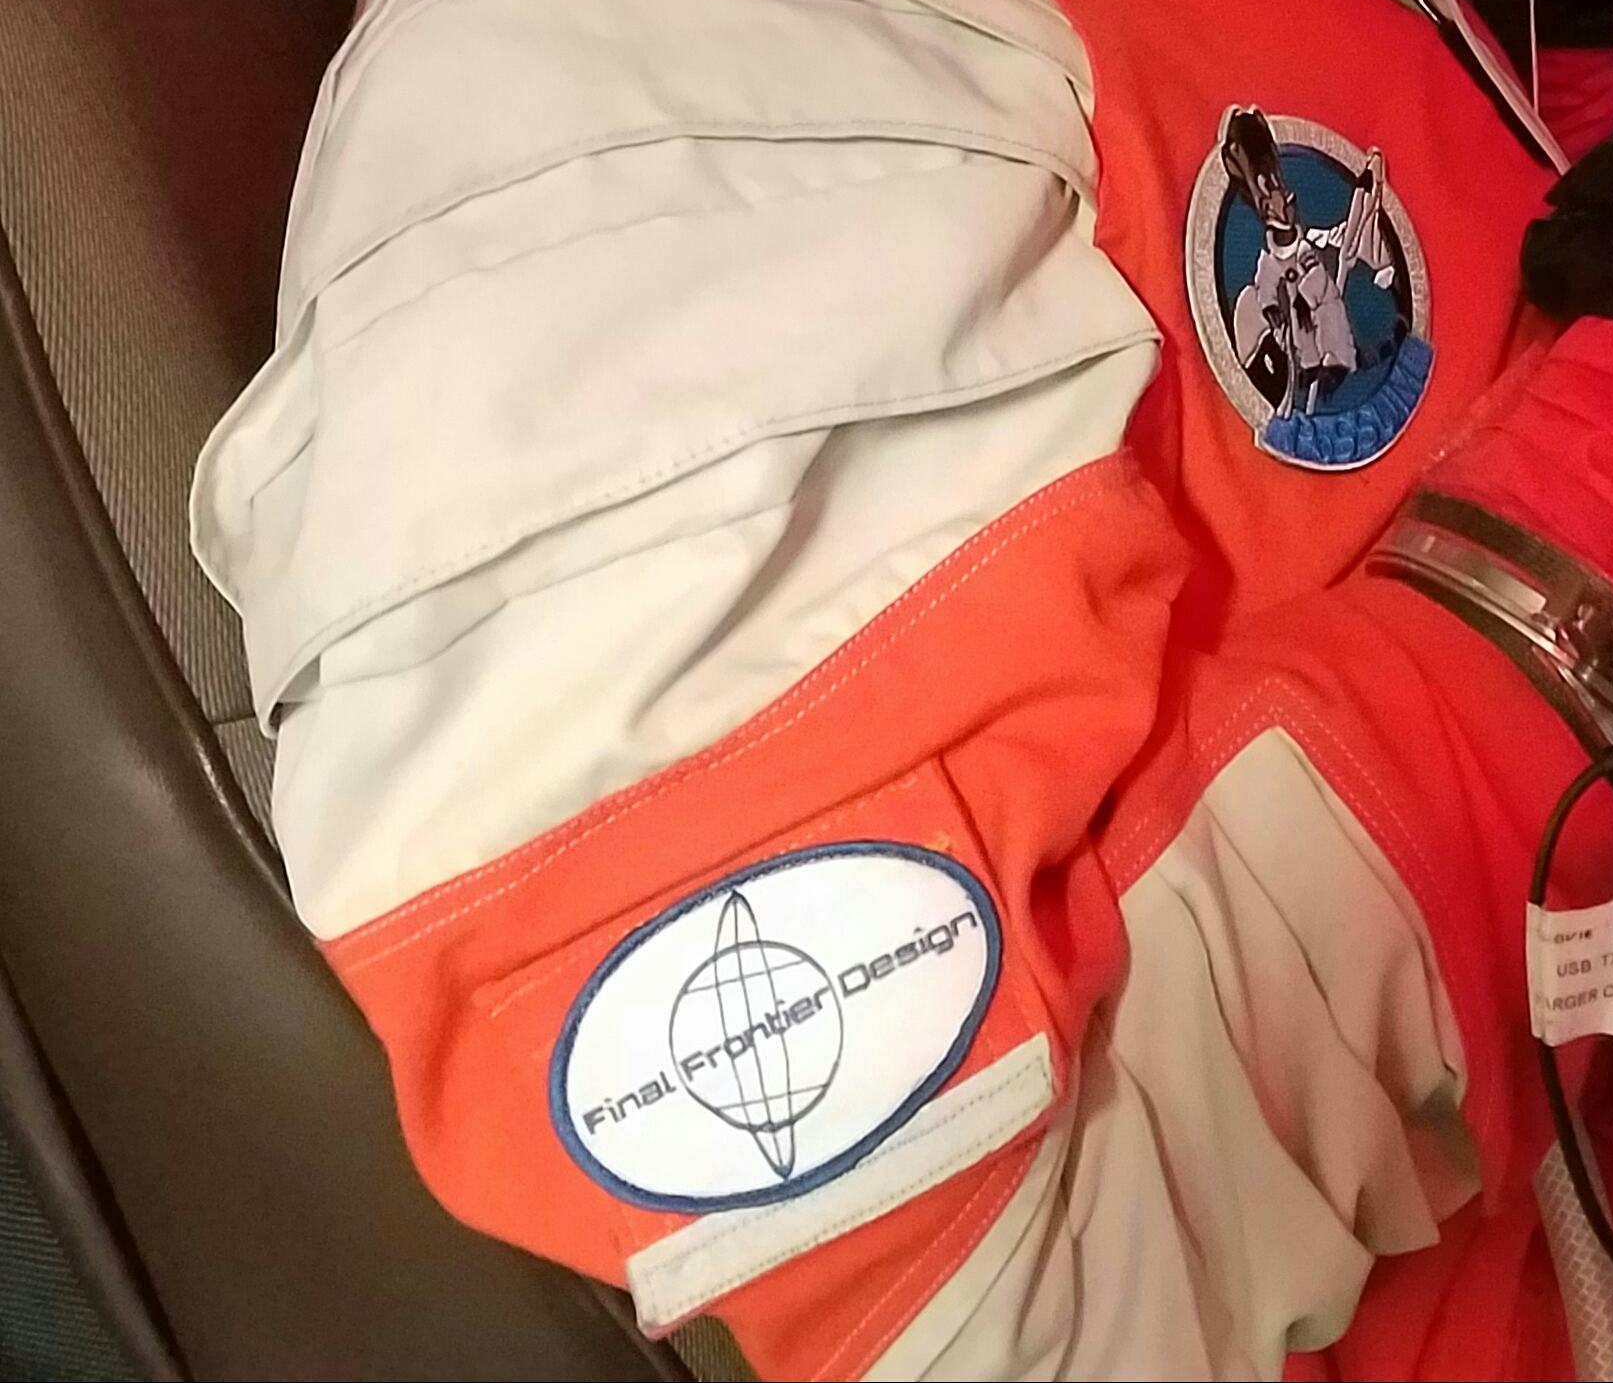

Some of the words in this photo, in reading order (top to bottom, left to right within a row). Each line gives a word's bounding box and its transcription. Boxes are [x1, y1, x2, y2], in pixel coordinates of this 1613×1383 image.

[581, 1070, 677, 1135] Final
[680, 985, 830, 1081] Frontier
[837, 910, 979, 998] Design
[1556, 959, 1593, 978] USB
